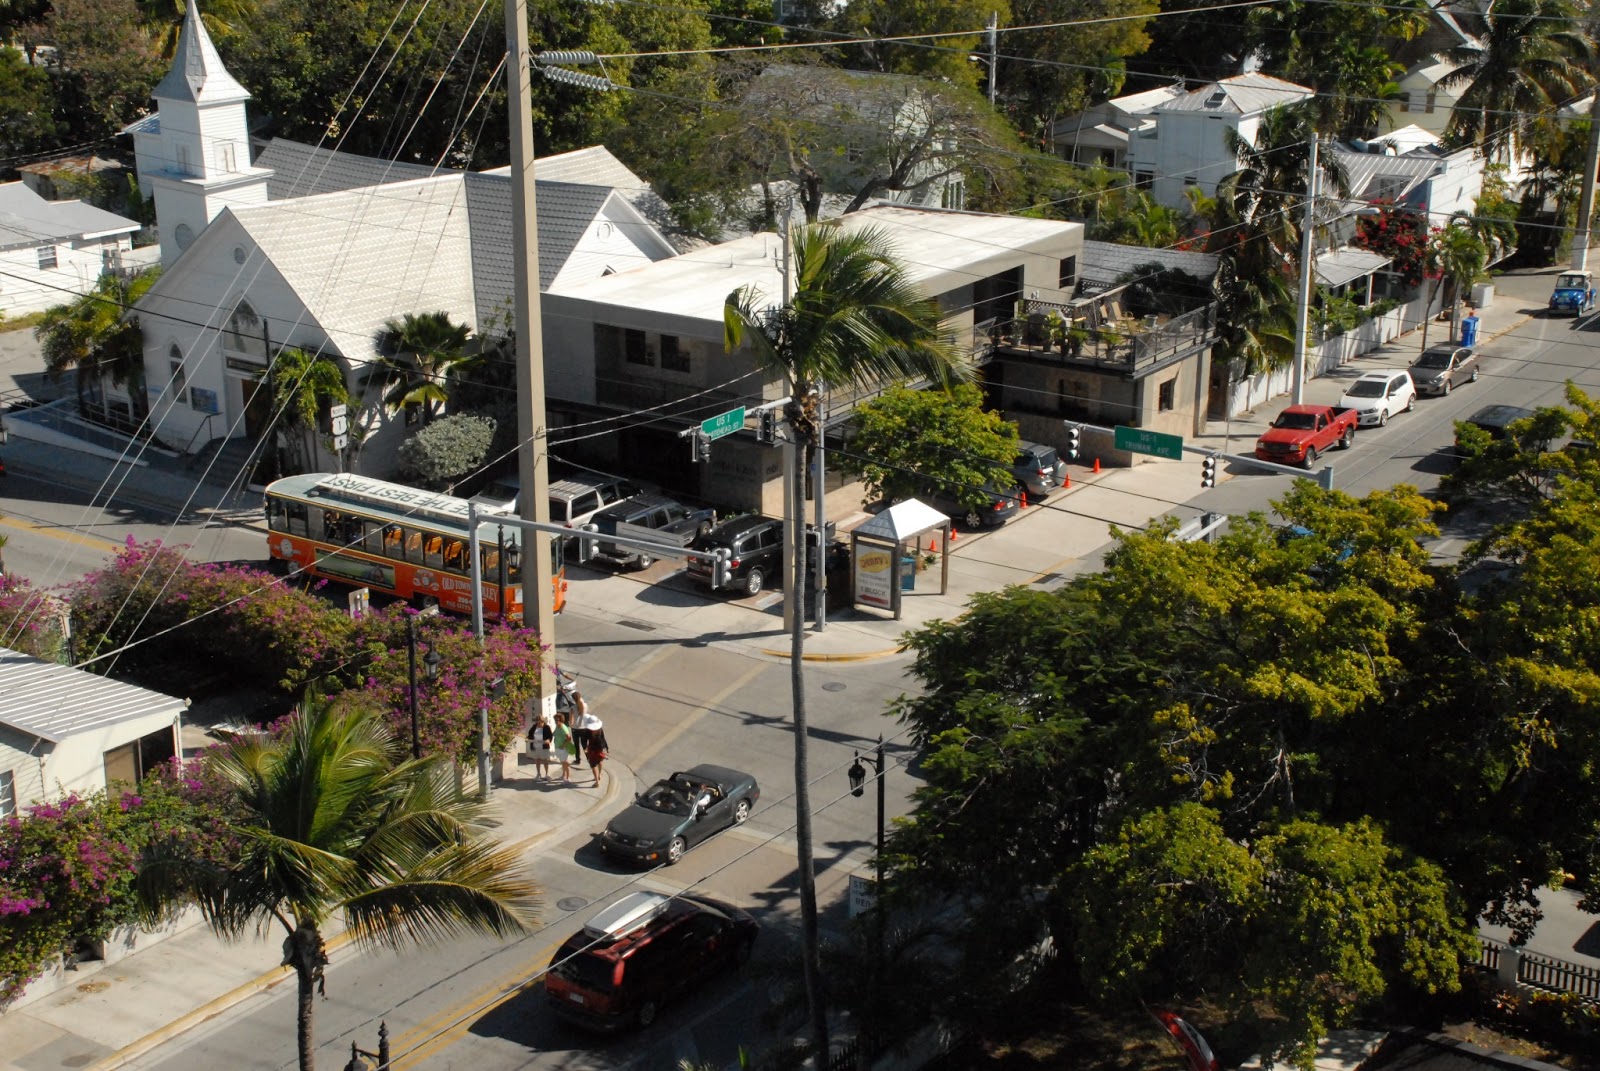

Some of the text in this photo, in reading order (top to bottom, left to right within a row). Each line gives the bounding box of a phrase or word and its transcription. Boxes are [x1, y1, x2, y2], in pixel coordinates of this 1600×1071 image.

[716, 416, 725, 426] US
[710, 421, 739, 438] HITEHEAD ST
[1125, 441, 1170, 456] TRUMAN AVE
[321, 476, 375, 494] FIRST
[371, 486, 419, 503] BEST
[413, 496, 452, 511] THE
[442, 576, 454, 590] OLD
[455, 580, 472, 591] TOWN
[864, 587, 886, 597] BLOCK
[446, 600, 456, 608] THE
[855, 897, 871, 908] RED
